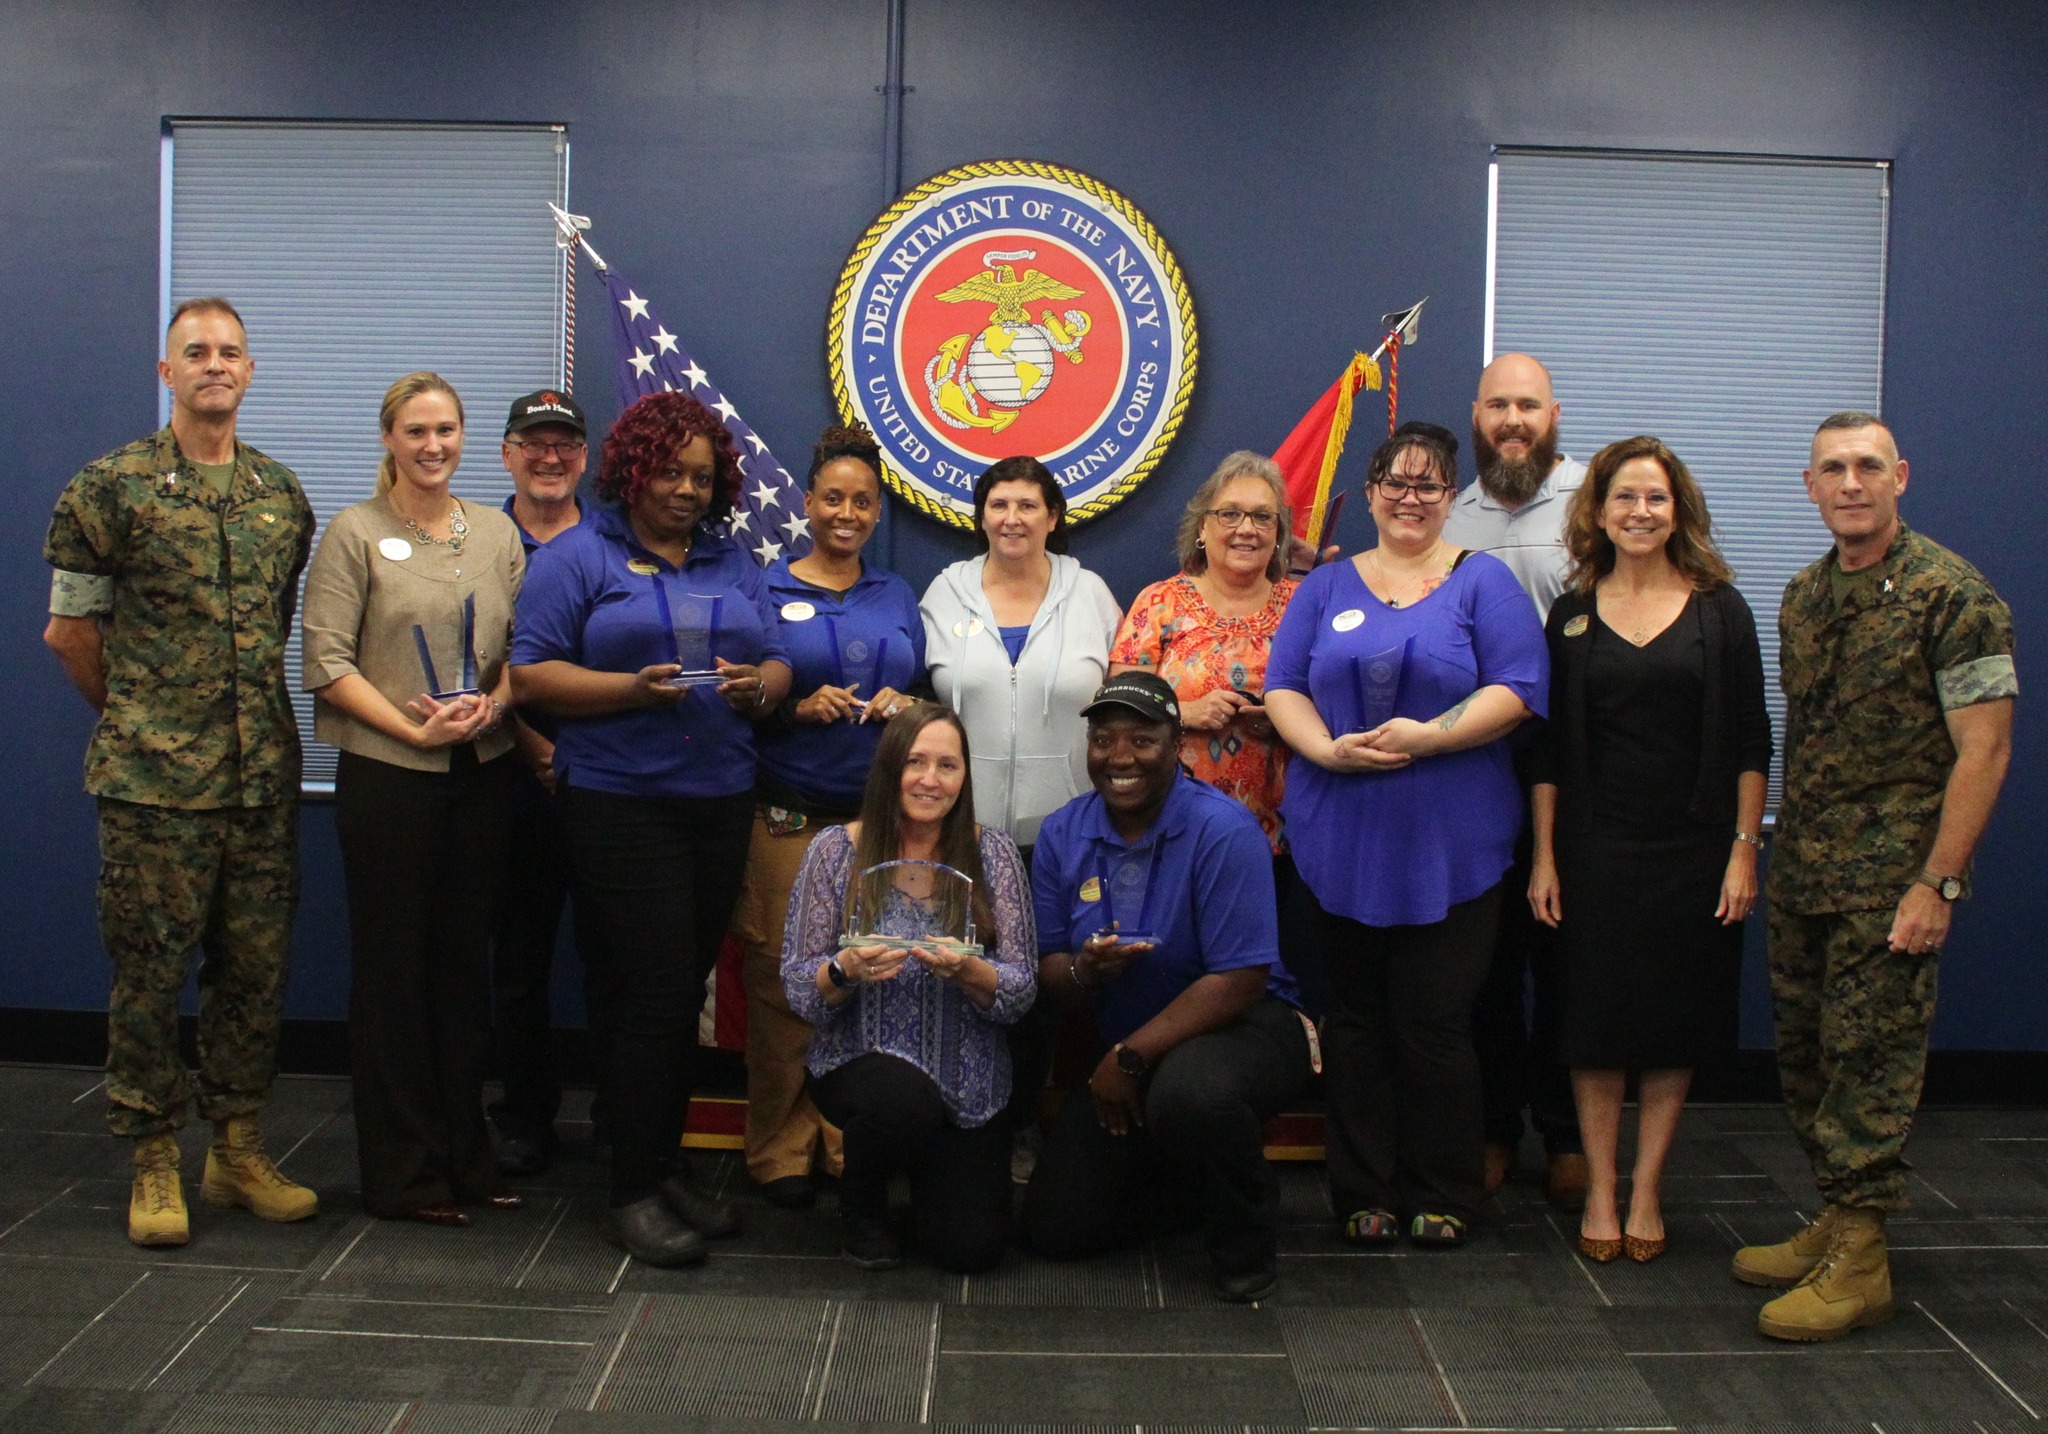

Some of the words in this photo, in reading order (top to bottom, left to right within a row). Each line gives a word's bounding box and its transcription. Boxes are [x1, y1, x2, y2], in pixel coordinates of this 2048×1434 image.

[861, 194, 1014, 346] DEPARTMENT
[1021, 199, 1054, 221] OF
[1059, 207, 1107, 247] THE
[1104, 244, 1161, 329] NAVY
[526, 403, 551, 414] Boar's
[868, 373, 931, 463] UNITED
[932, 460, 981, 492] STA
[1053, 437, 1120, 488] ARINE
[1117, 361, 1158, 437] CORPS
[1104, 685, 1149, 696] STARBUCKS
